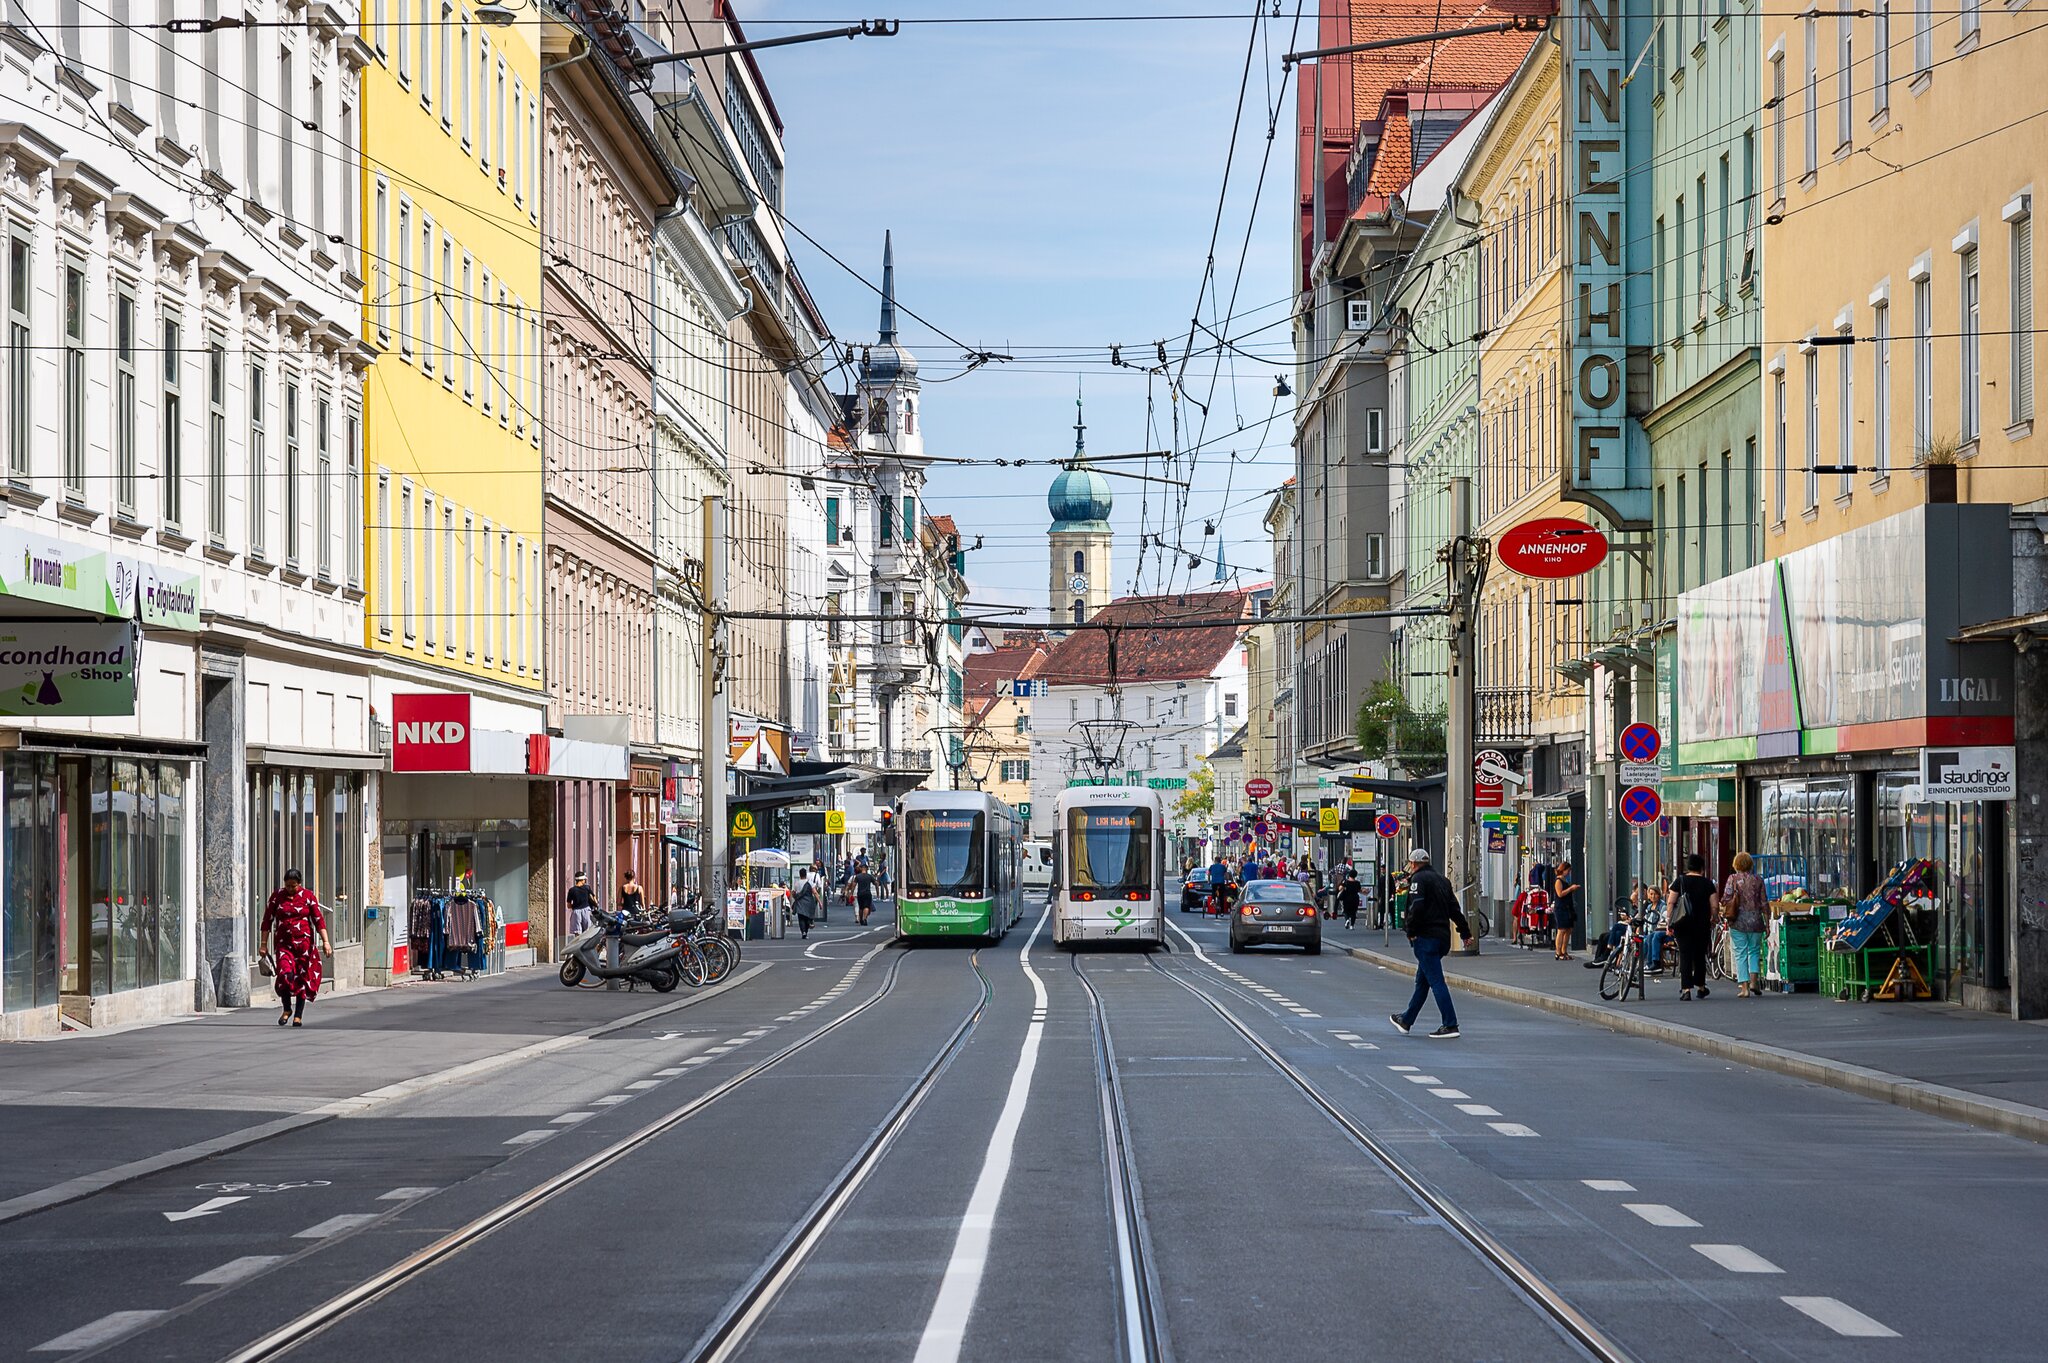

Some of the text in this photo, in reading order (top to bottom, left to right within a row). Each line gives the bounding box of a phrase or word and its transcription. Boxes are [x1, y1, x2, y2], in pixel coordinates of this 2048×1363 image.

[1518, 543, 1588, 555] ANNENHOF
[33, 557, 43, 586] pro
[44, 559, 62, 588] mente
[156, 581, 195, 617] digitaldruck
[80, 668, 123, 682] Shop
[397, 721, 465, 744] NKD
[1480, 752, 1506, 766] TABAK
[1475, 765, 1499, 783] TRAFIK
[1943, 769, 2010, 785] staudinger
[1928, 785, 2011, 794] EINRICHTUNGSSTUDIO
[1630, 819, 1652, 827] ANFANG
